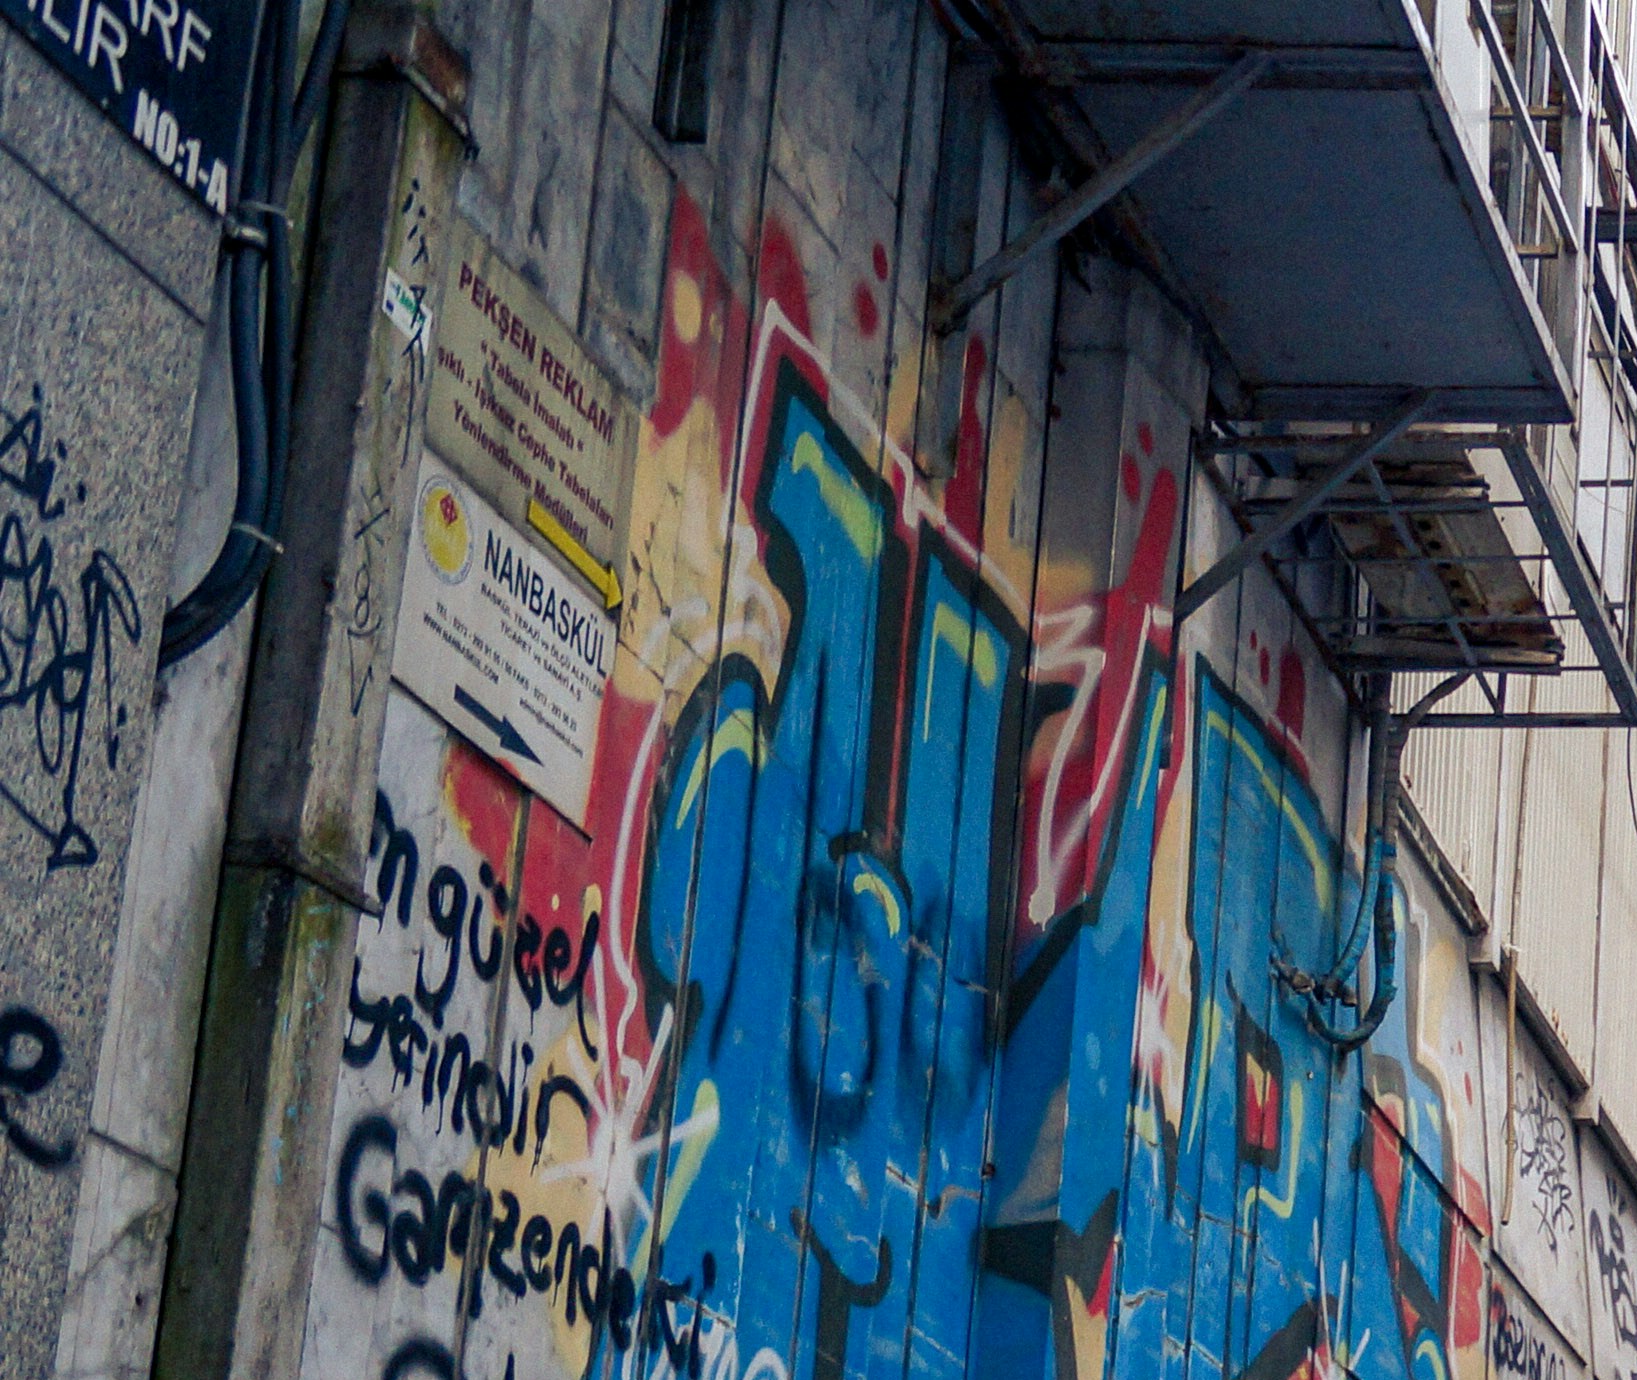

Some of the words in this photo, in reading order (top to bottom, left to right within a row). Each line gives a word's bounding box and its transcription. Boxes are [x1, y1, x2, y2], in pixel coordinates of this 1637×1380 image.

[27, 0, 129, 95] LIR
[127, 0, 213, 72] RF
[133, 87, 229, 217] NO:1-A
[458, 260, 537, 364] PEKŞEN
[540, 346, 614, 445] REKLAM
[484, 530, 607, 679] NANBASKÜL
